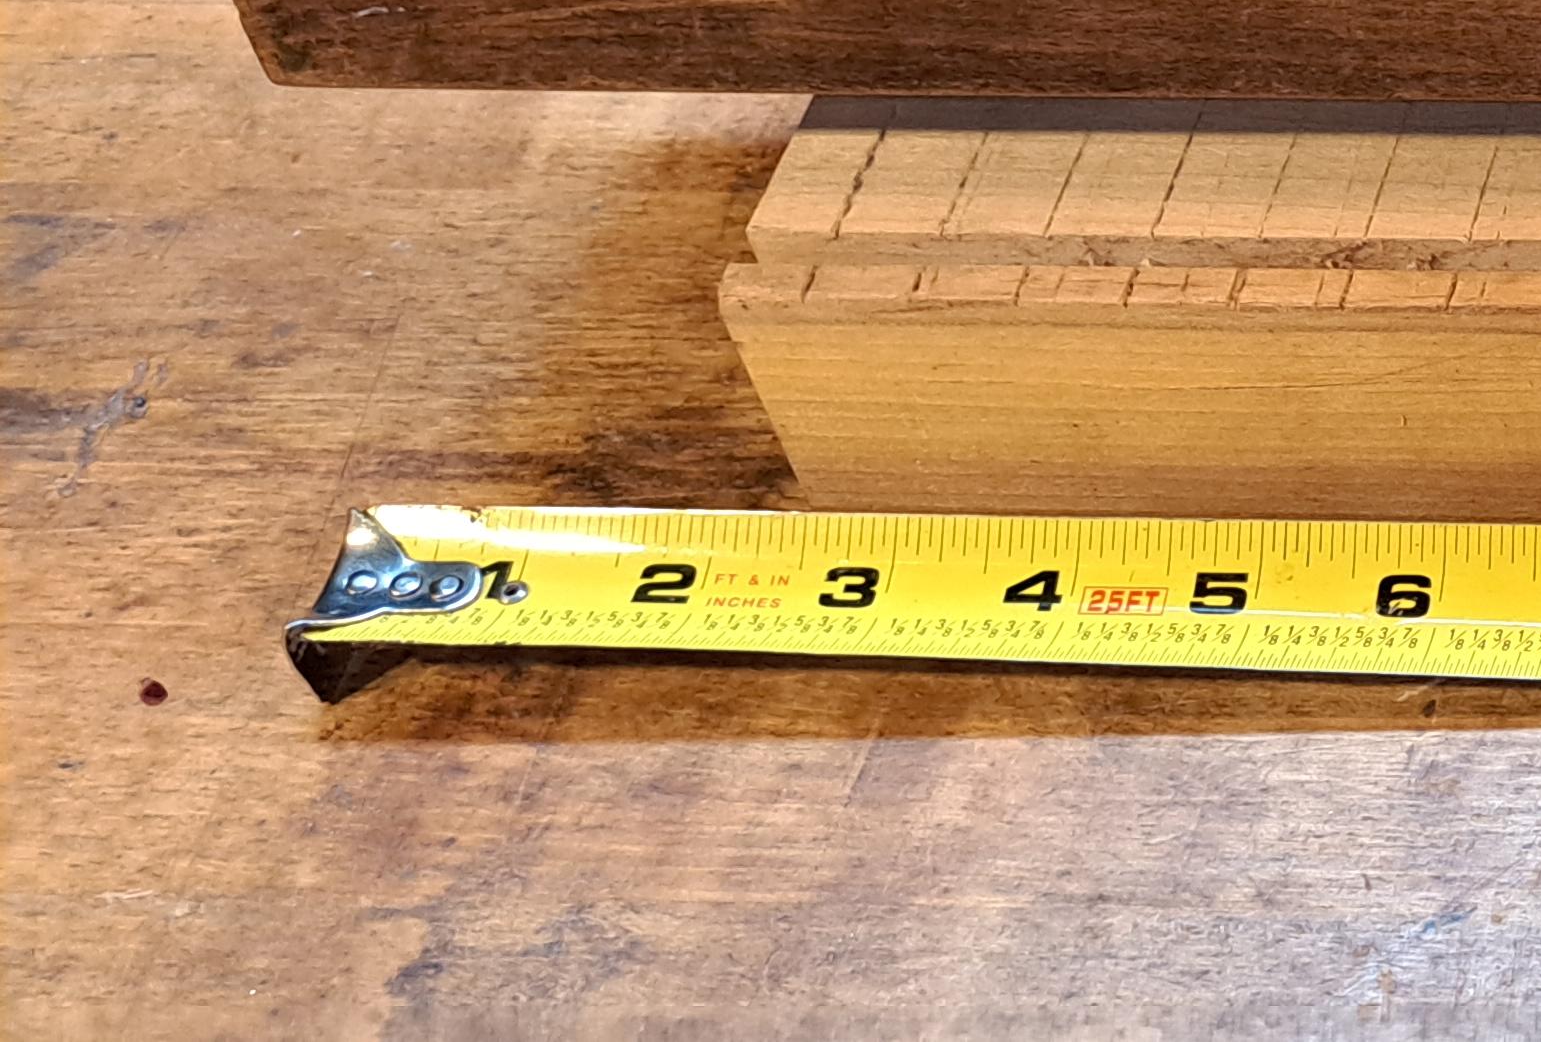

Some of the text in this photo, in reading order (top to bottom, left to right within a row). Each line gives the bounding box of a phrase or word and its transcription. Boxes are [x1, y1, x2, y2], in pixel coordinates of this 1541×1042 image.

[631, 563, 697, 604] 2
[713, 573, 791, 587] FT & IN
[818, 567, 880, 608] 3
[1003, 570, 1063, 612] 4
[1087, 588, 1162, 613] 25FT
[1189, 572, 1249, 614] 5
[1375, 574, 1432, 618] 6
[705, 596, 783, 609] INCHES
